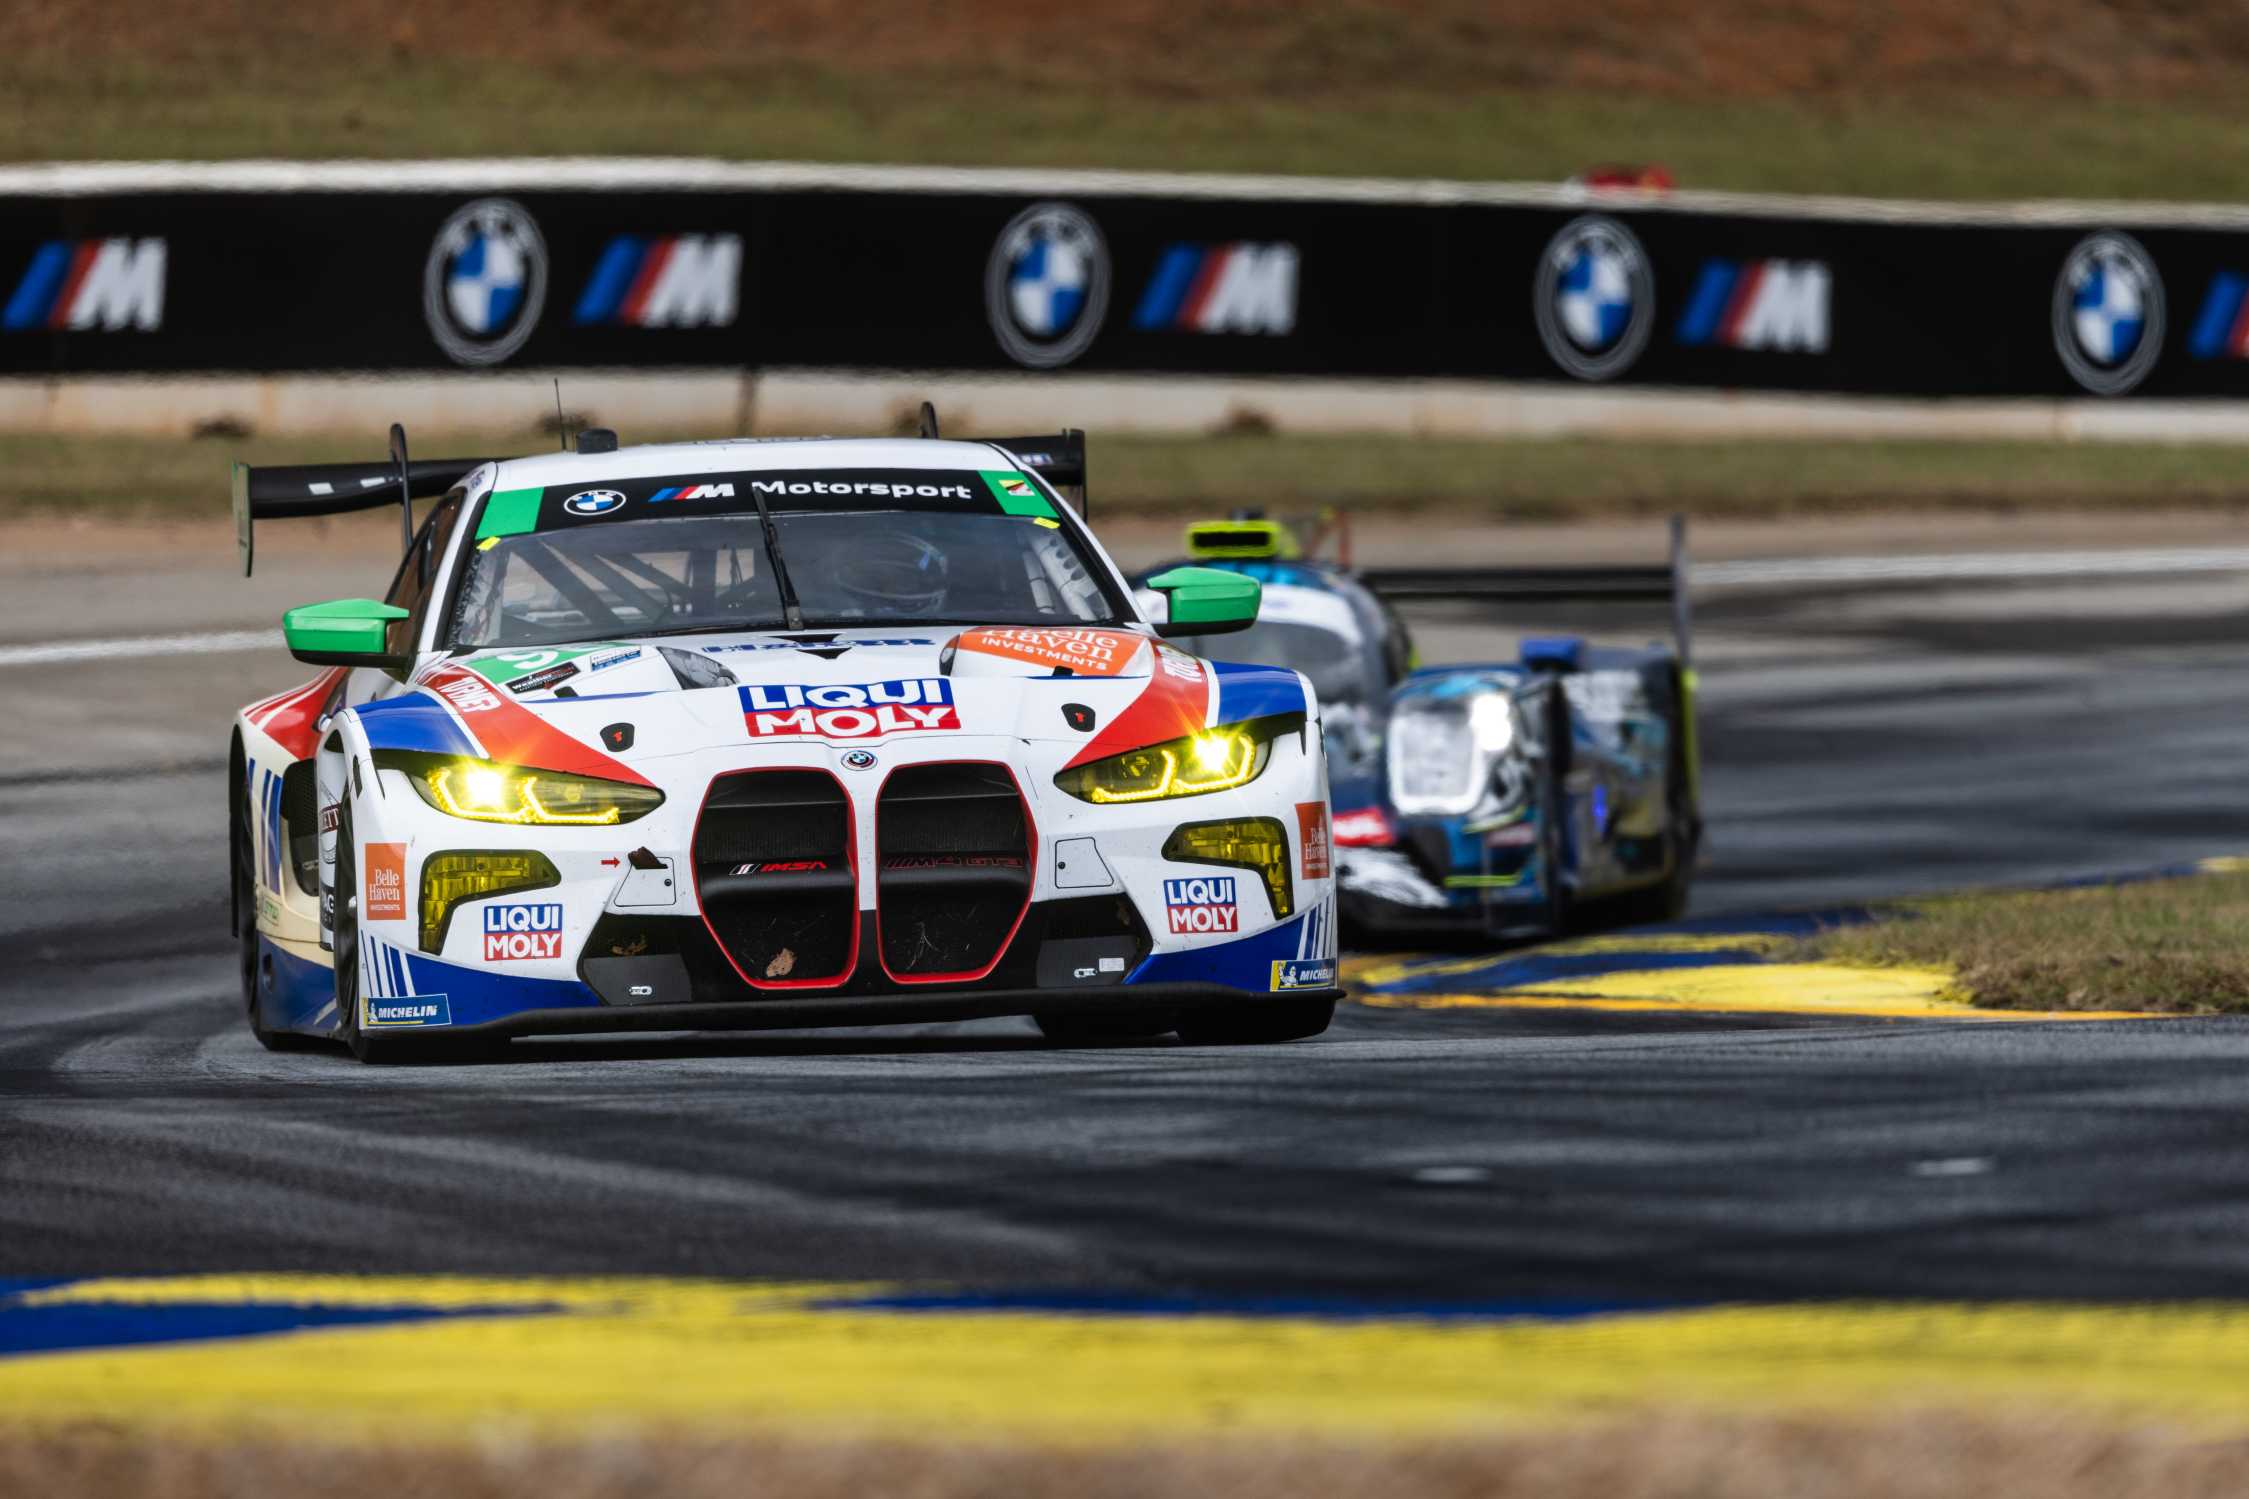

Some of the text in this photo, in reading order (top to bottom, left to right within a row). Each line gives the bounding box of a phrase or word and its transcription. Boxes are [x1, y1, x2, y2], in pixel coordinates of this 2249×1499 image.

[67, 237, 166, 331] M
[645, 232, 742, 328] M
[1202, 241, 1298, 336] M
[1743, 259, 1832, 353] M
[751, 480, 973, 499] Motorsport
[1041, 629, 1118, 648] elle
[981, 637, 1109, 671] INVESTMENTS
[749, 680, 944, 709] LIQUI
[755, 706, 953, 737] MOLY
[375, 868, 400, 887] Belle
[760, 861, 827, 872] IMSA
[369, 883, 401, 901] Haven
[1166, 879, 1233, 905] LIQUI
[487, 906, 560, 932] LIQUI
[1170, 906, 1237, 932] MOLY
[487, 934, 561, 960] MOLY
[378, 1005, 438, 1019] MICHELIN
